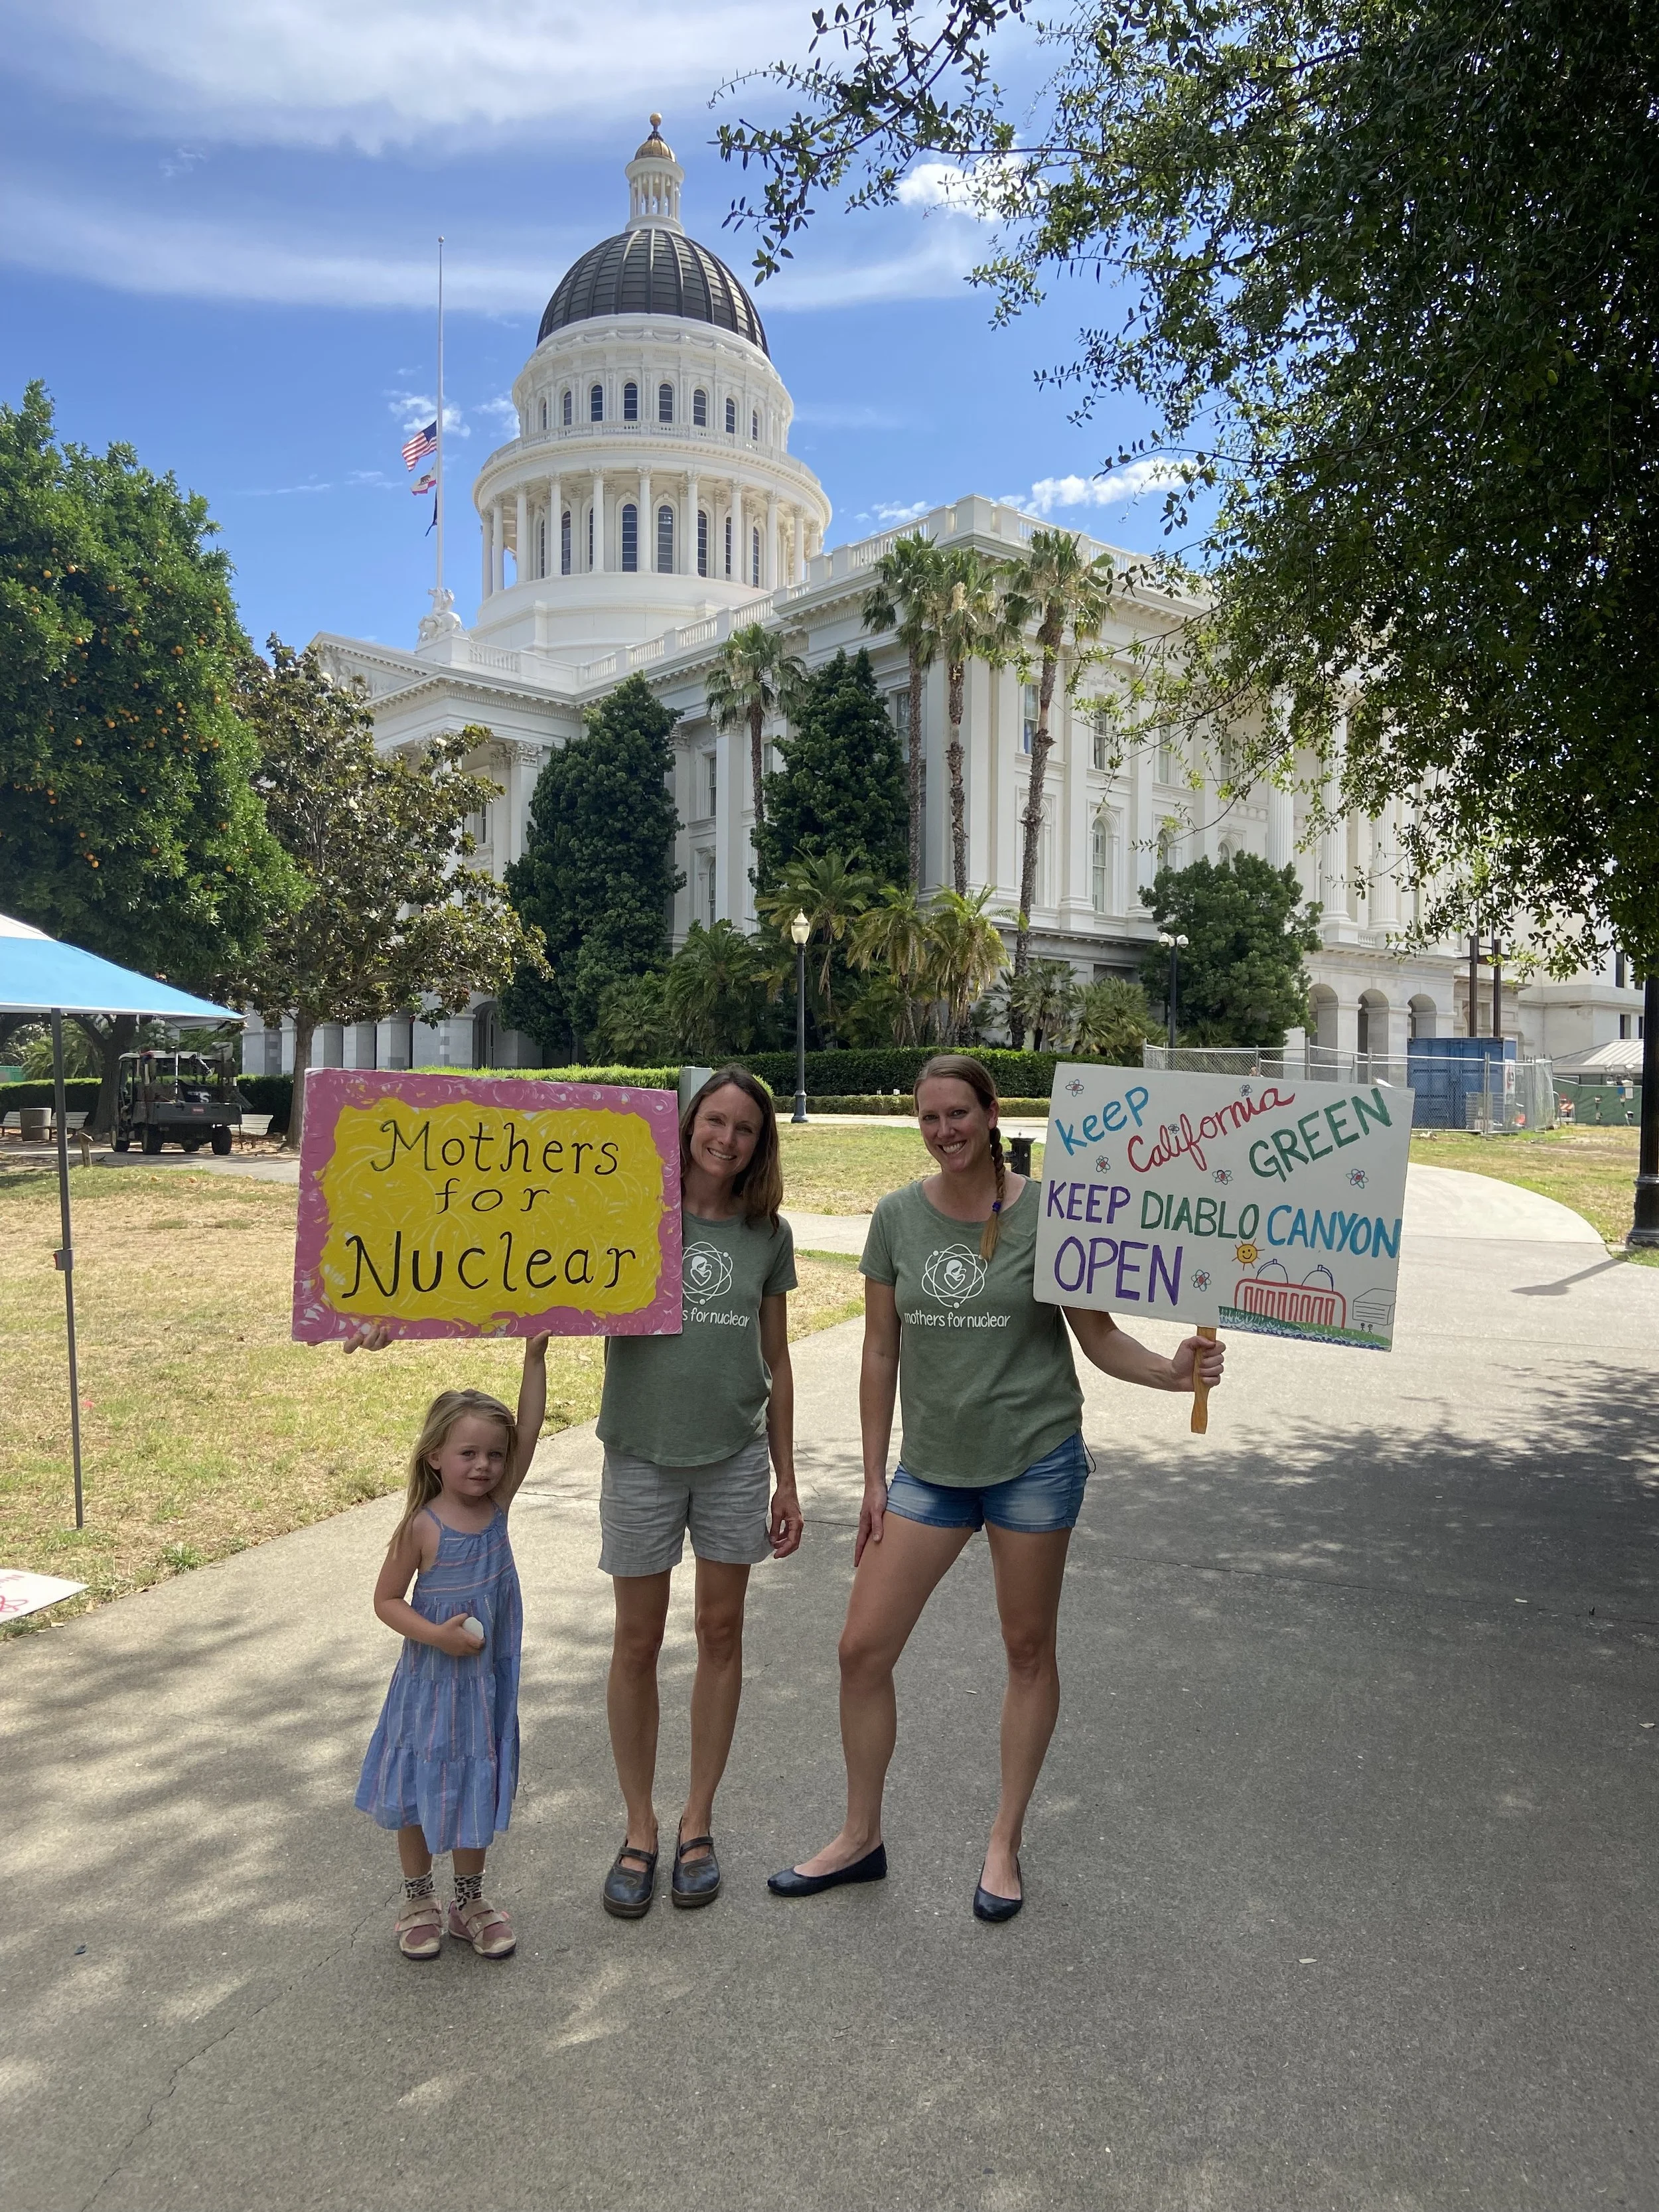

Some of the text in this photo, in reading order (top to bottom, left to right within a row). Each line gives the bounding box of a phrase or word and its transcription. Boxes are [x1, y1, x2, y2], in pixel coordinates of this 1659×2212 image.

[370, 1119, 618, 1175] Mothers
[1127, 1087, 1296, 1172] California
[1249, 1088, 1393, 1183] GREEN
[435, 1177, 550, 1215] for
[1047, 1180, 1402, 1258] KEEP DIABLO CANYON
[341, 1230, 636, 1299] Nuclear
[1054, 1236, 1183, 1306] OPEN
[691, 1307, 709, 1323] for
[709, 1310, 750, 1327] nuclear
[904, 1309, 1011, 1328] mothers for nuclear
